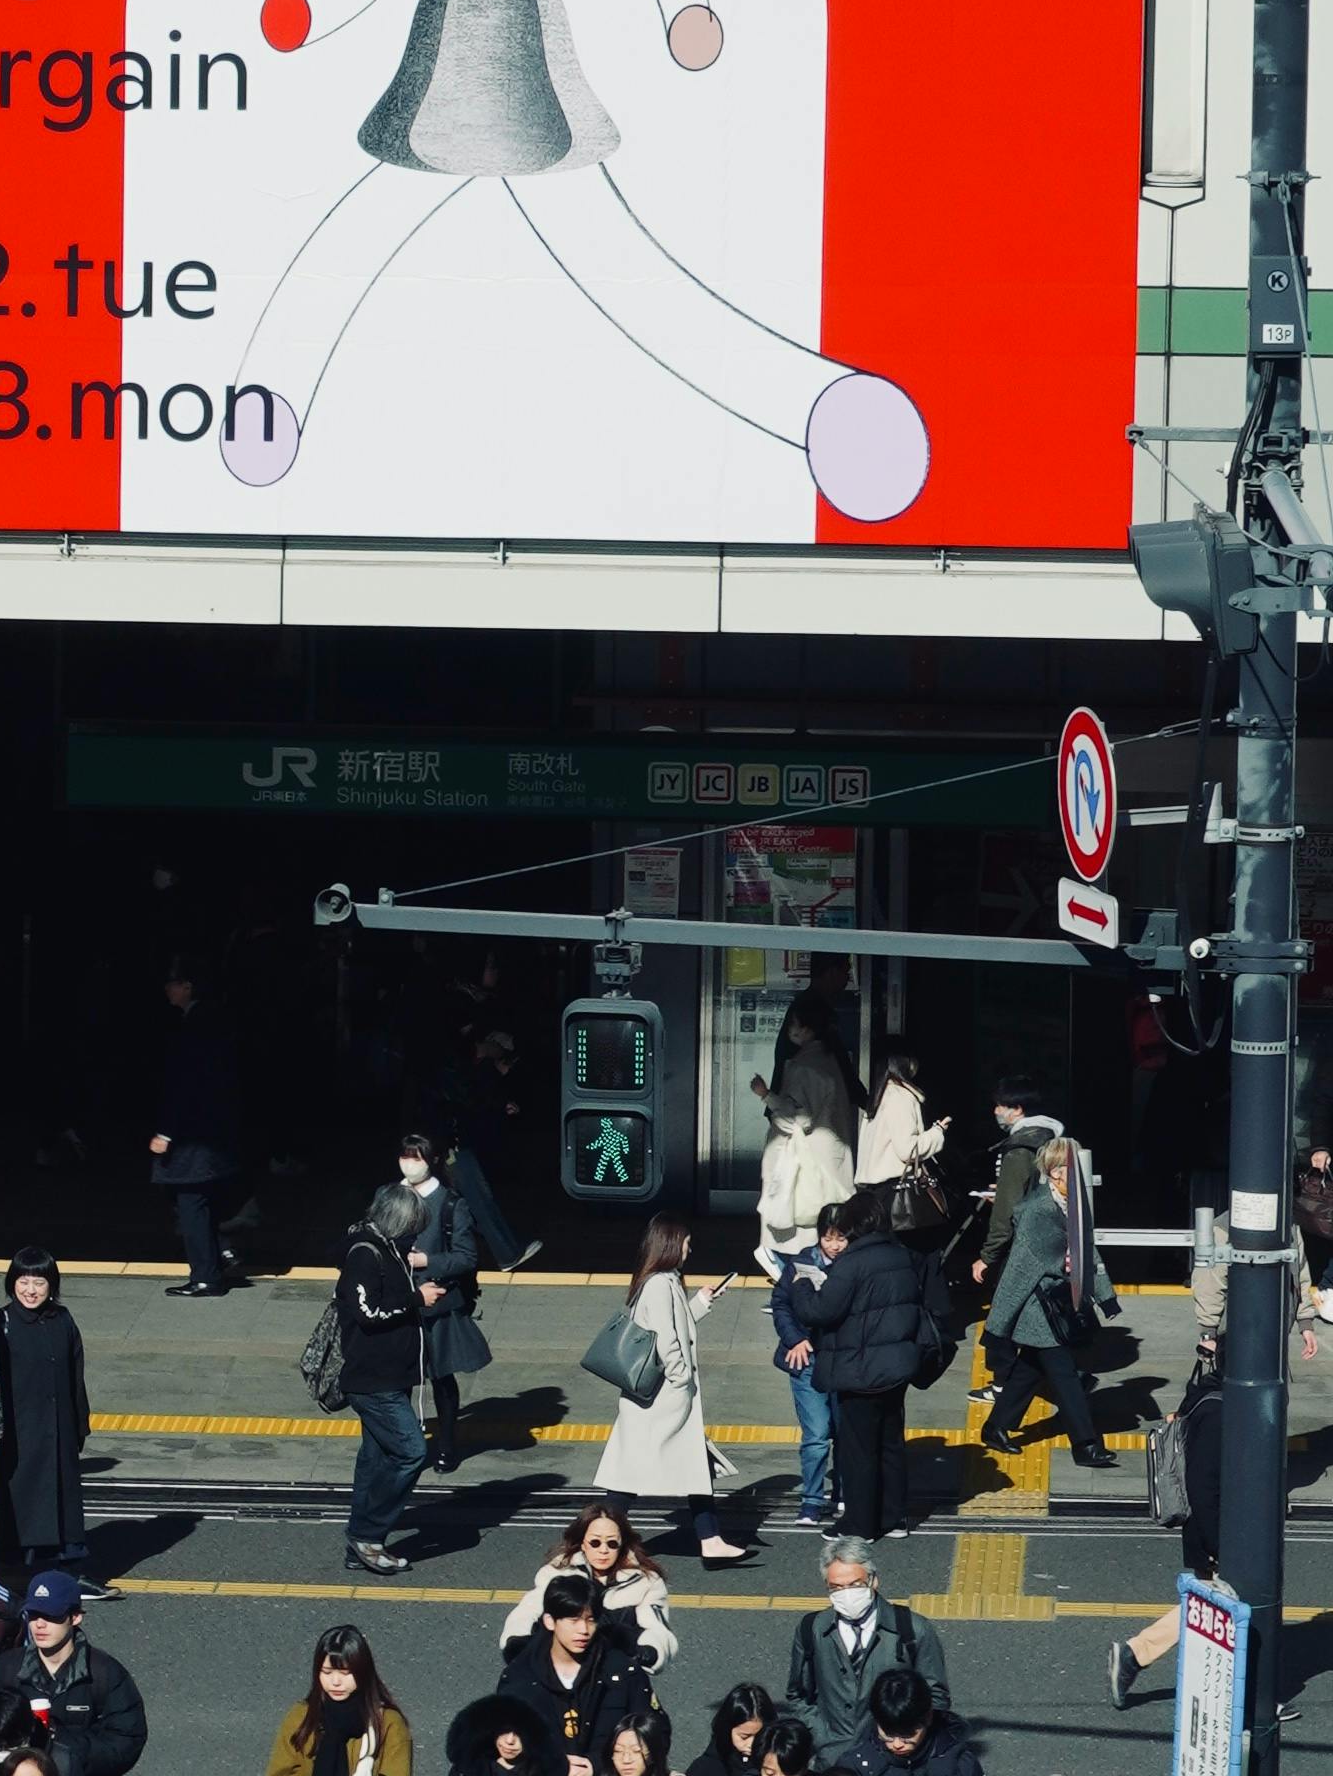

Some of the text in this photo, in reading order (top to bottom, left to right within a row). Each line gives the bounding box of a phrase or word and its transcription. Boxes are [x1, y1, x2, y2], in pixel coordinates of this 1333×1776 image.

[1267, 327, 1292, 342] 13P
[242, 746, 318, 788] JR
[336, 749, 441, 783] 新宿駅
[508, 752, 580, 776] 南改札
[336, 787, 416, 808] Shinjuku
[422, 790, 489, 808] Station
[1188, 1596, 1236, 1648] お知らせ
